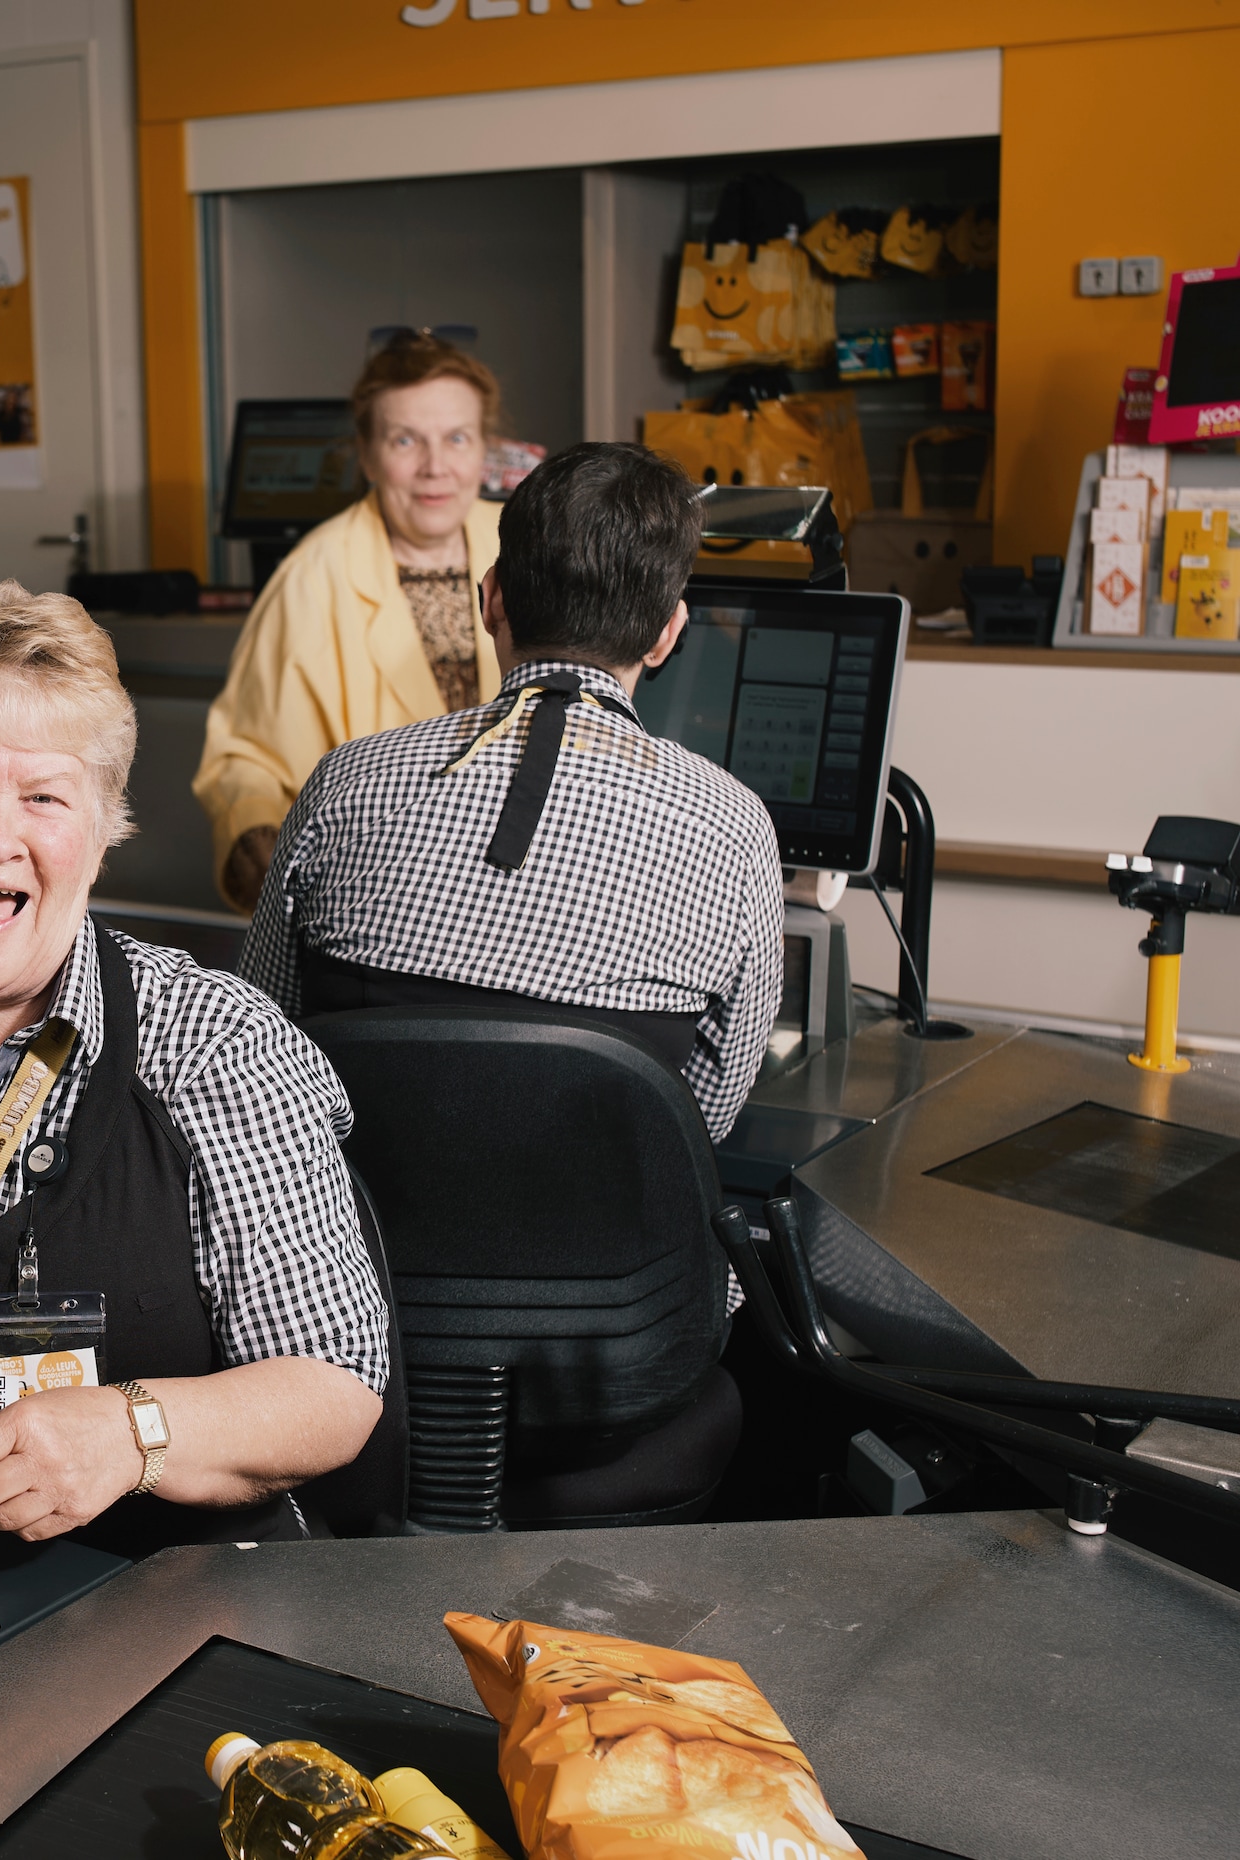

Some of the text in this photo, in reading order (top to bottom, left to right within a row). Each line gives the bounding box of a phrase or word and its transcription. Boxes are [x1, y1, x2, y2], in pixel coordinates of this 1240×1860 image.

[56, 1361, 78, 1371] LEUK
[38, 1369, 82, 1381] BOODSCHAPPEN
[46, 1377, 72, 1388] DOEN
